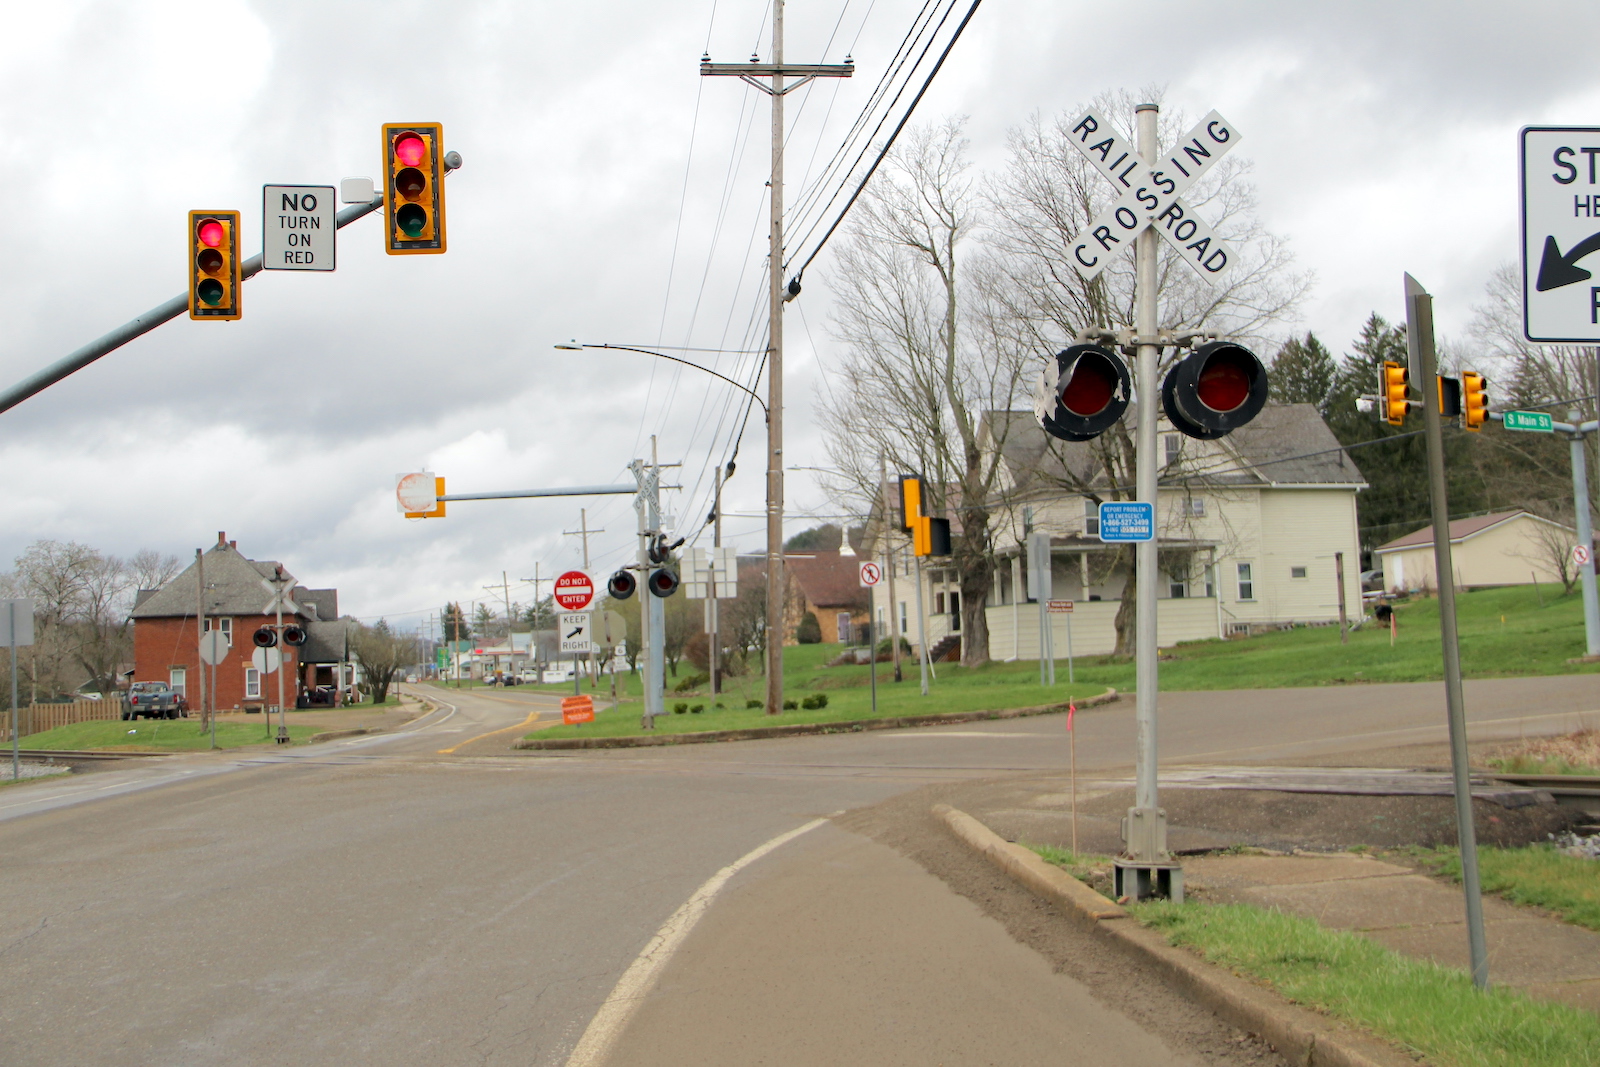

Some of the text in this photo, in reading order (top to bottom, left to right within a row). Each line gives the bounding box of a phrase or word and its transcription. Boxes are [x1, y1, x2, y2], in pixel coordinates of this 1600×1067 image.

[1072, 115, 1138, 188] RAIL
[1074, 120, 1230, 268] CROSSING
[282, 193, 317, 212] NO
[278, 215, 320, 229] TURN
[288, 233, 311, 247] ON
[1158, 202, 1227, 273] ROAD
[284, 250, 314, 264] RED
[1507, 413, 1549, 428] S Main St
[632, 461, 643, 484] RAIL
[635, 466, 659, 510] CROSSING
[647, 491, 660, 513] ROAD
[560, 577, 587, 586] DO NOT
[562, 595, 586, 603] ENTER
[563, 615, 586, 623] KEEP
[562, 641, 589, 649] RIGHT
